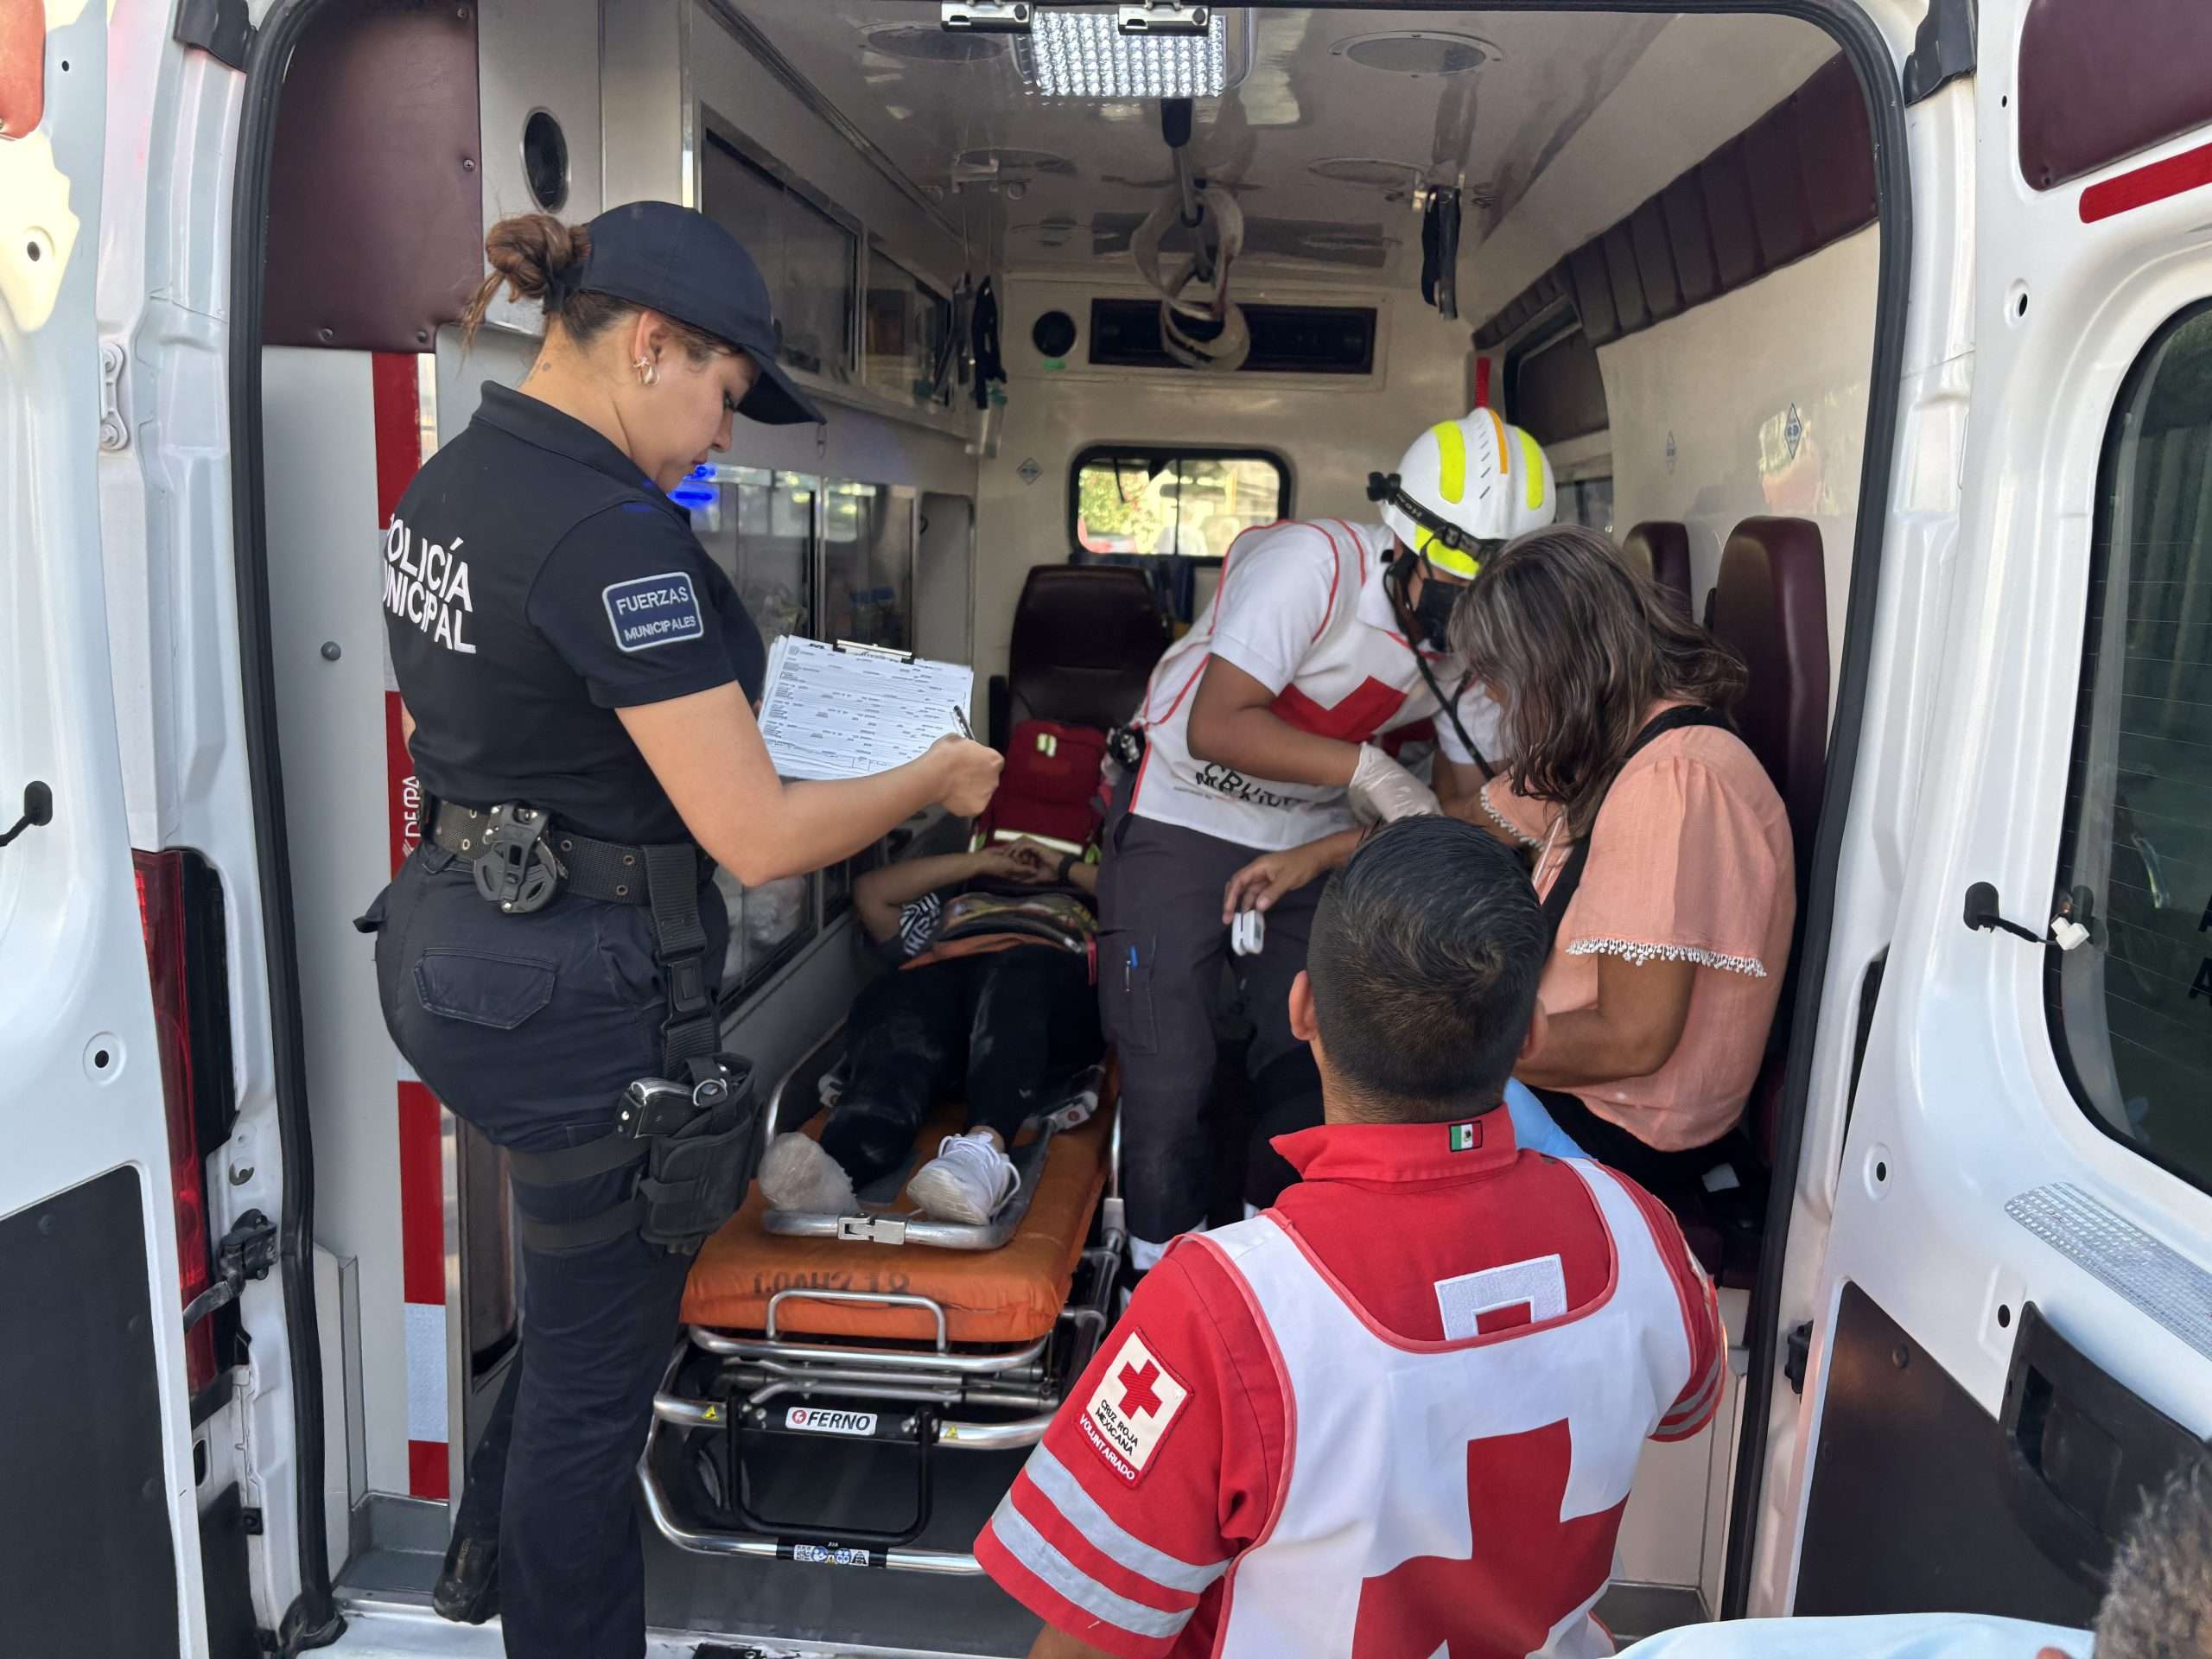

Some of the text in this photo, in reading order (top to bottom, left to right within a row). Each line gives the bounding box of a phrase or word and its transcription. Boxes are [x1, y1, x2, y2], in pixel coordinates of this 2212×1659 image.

[616, 586, 690, 616] FUERZAS
[623, 615, 696, 642] MUNICIPALES
[806, 1411, 871, 1431] FERNO
[1095, 1406, 1134, 1457] MEXICANA
[1100, 1398, 1139, 1447] CRUZ ROJA
[1079, 1413, 1135, 1480] VOLUNTARIADO
